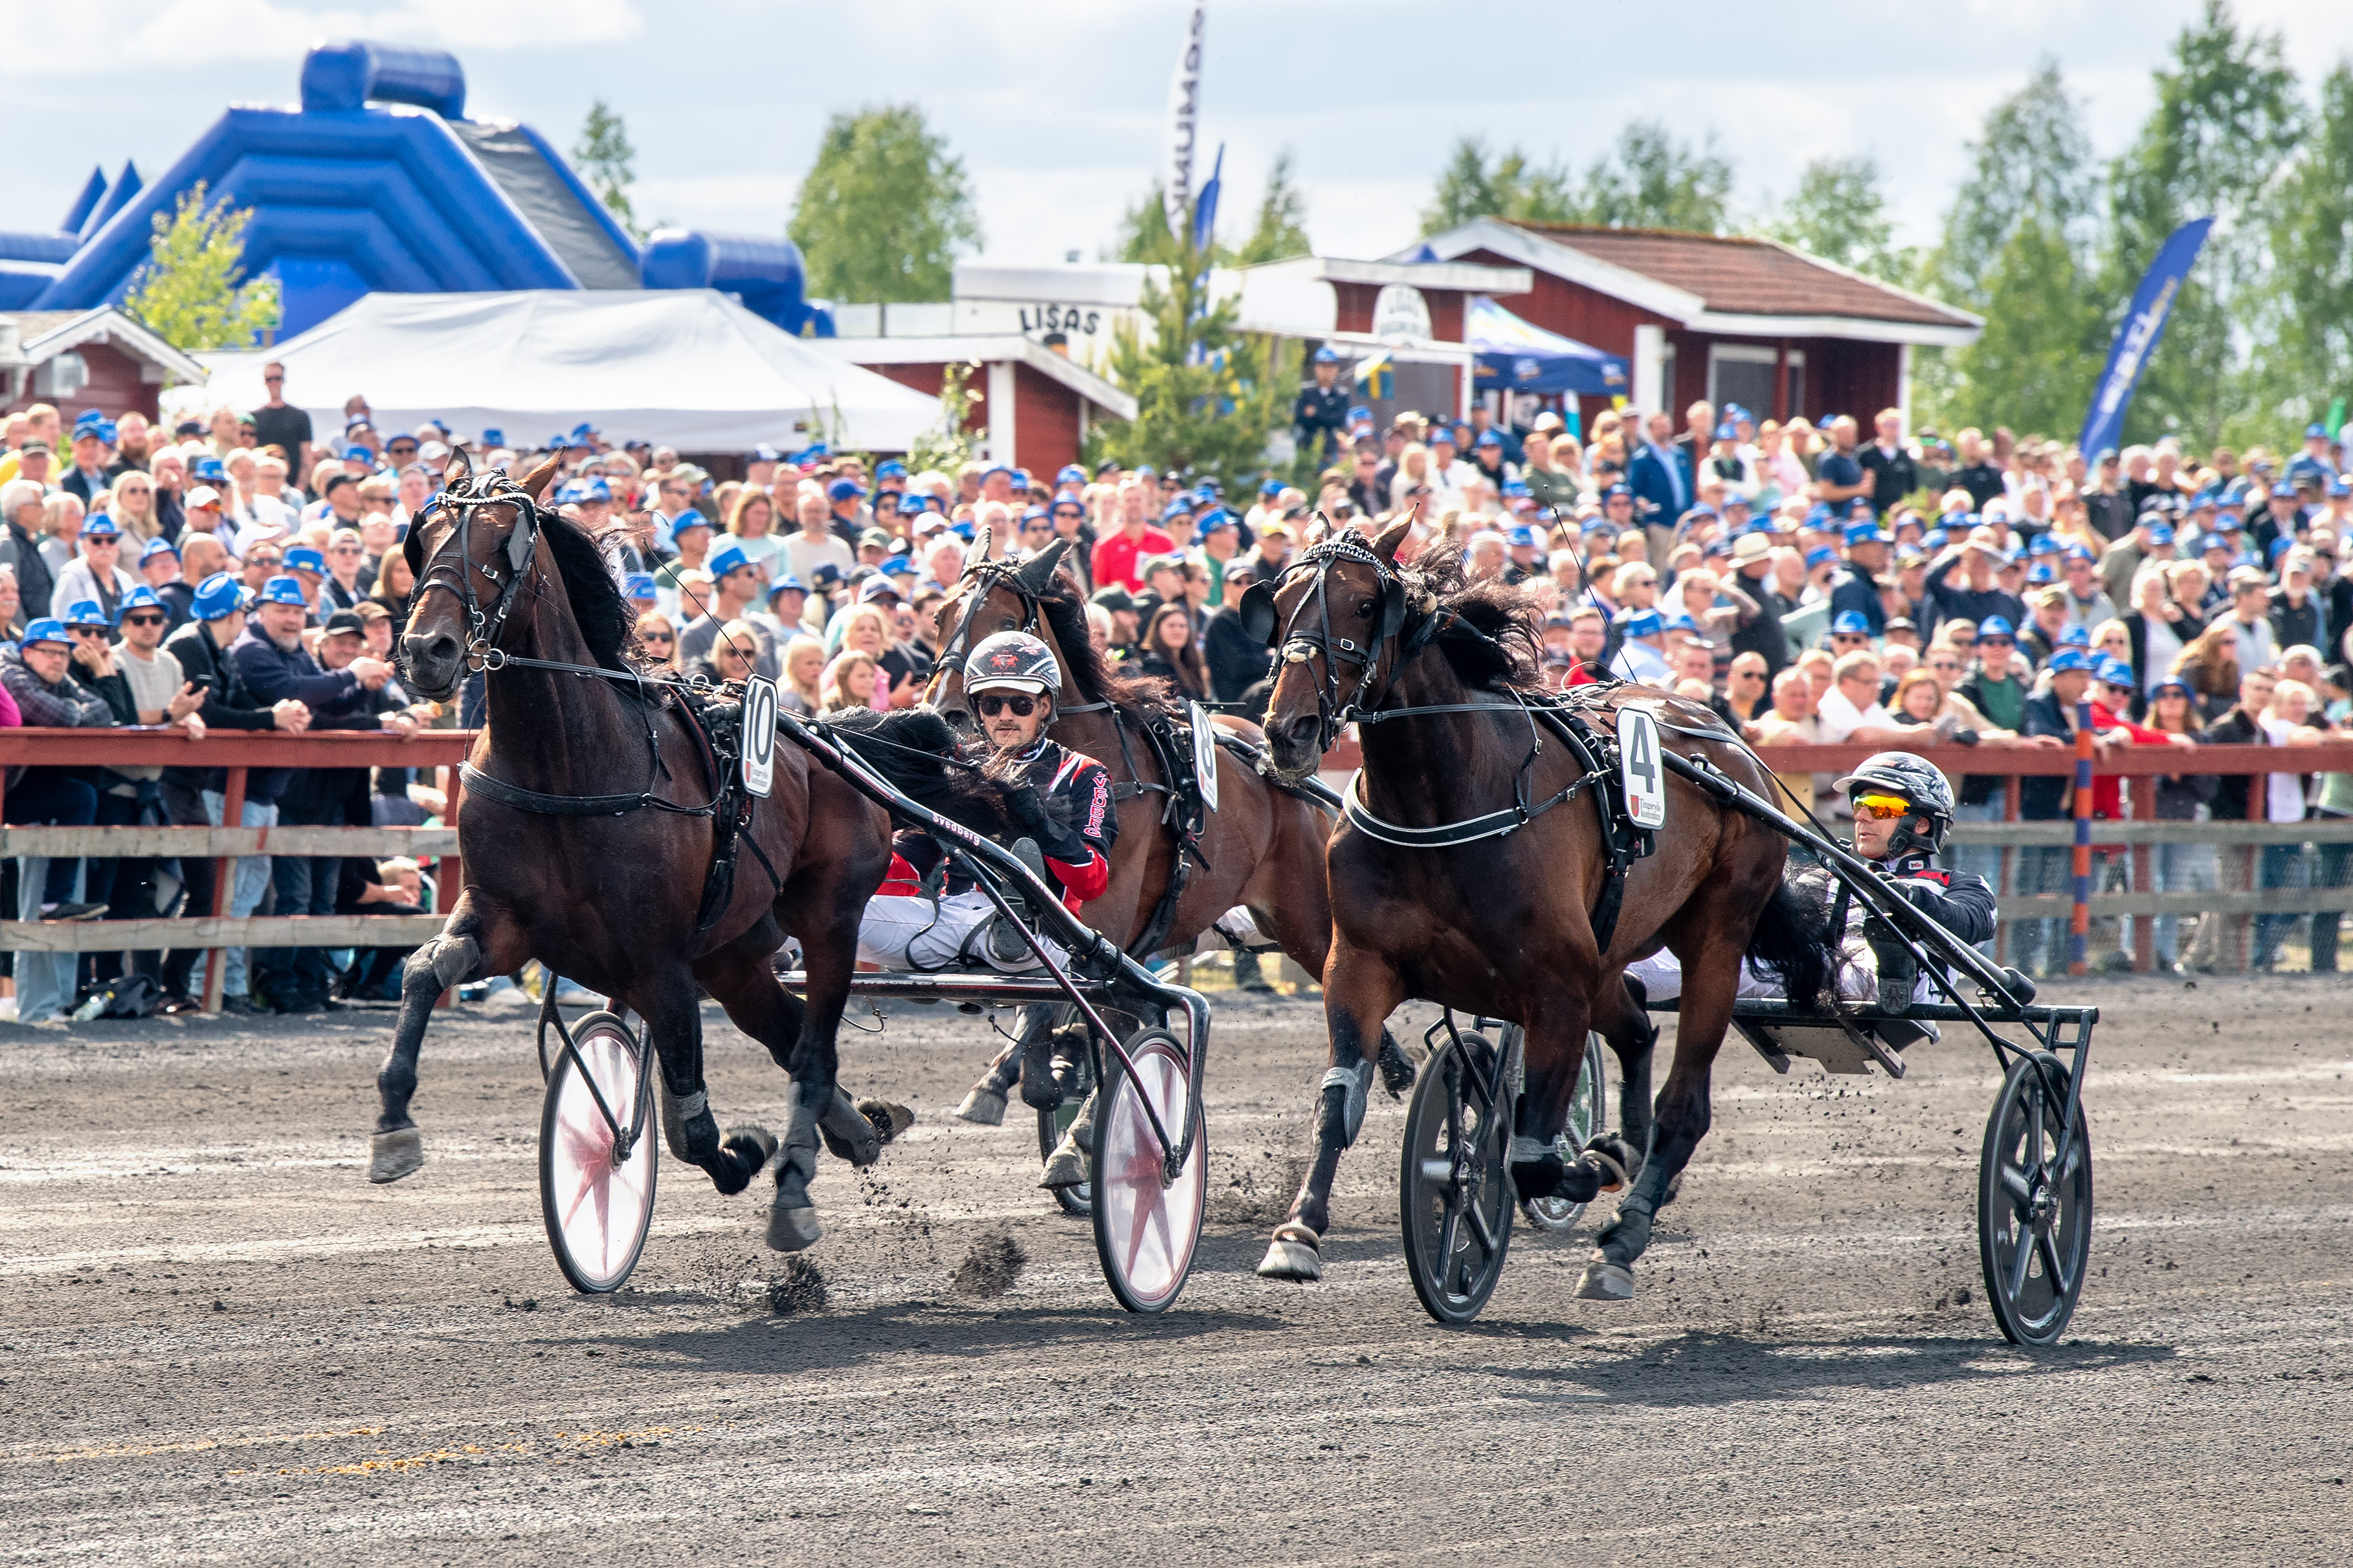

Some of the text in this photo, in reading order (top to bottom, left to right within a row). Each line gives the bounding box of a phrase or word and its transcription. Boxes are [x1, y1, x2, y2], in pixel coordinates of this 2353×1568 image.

[1020, 306, 1100, 335] LISAS
[748, 681, 775, 766] 10
[1198, 711, 1214, 780] 8
[1629, 715, 1656, 794] 4
